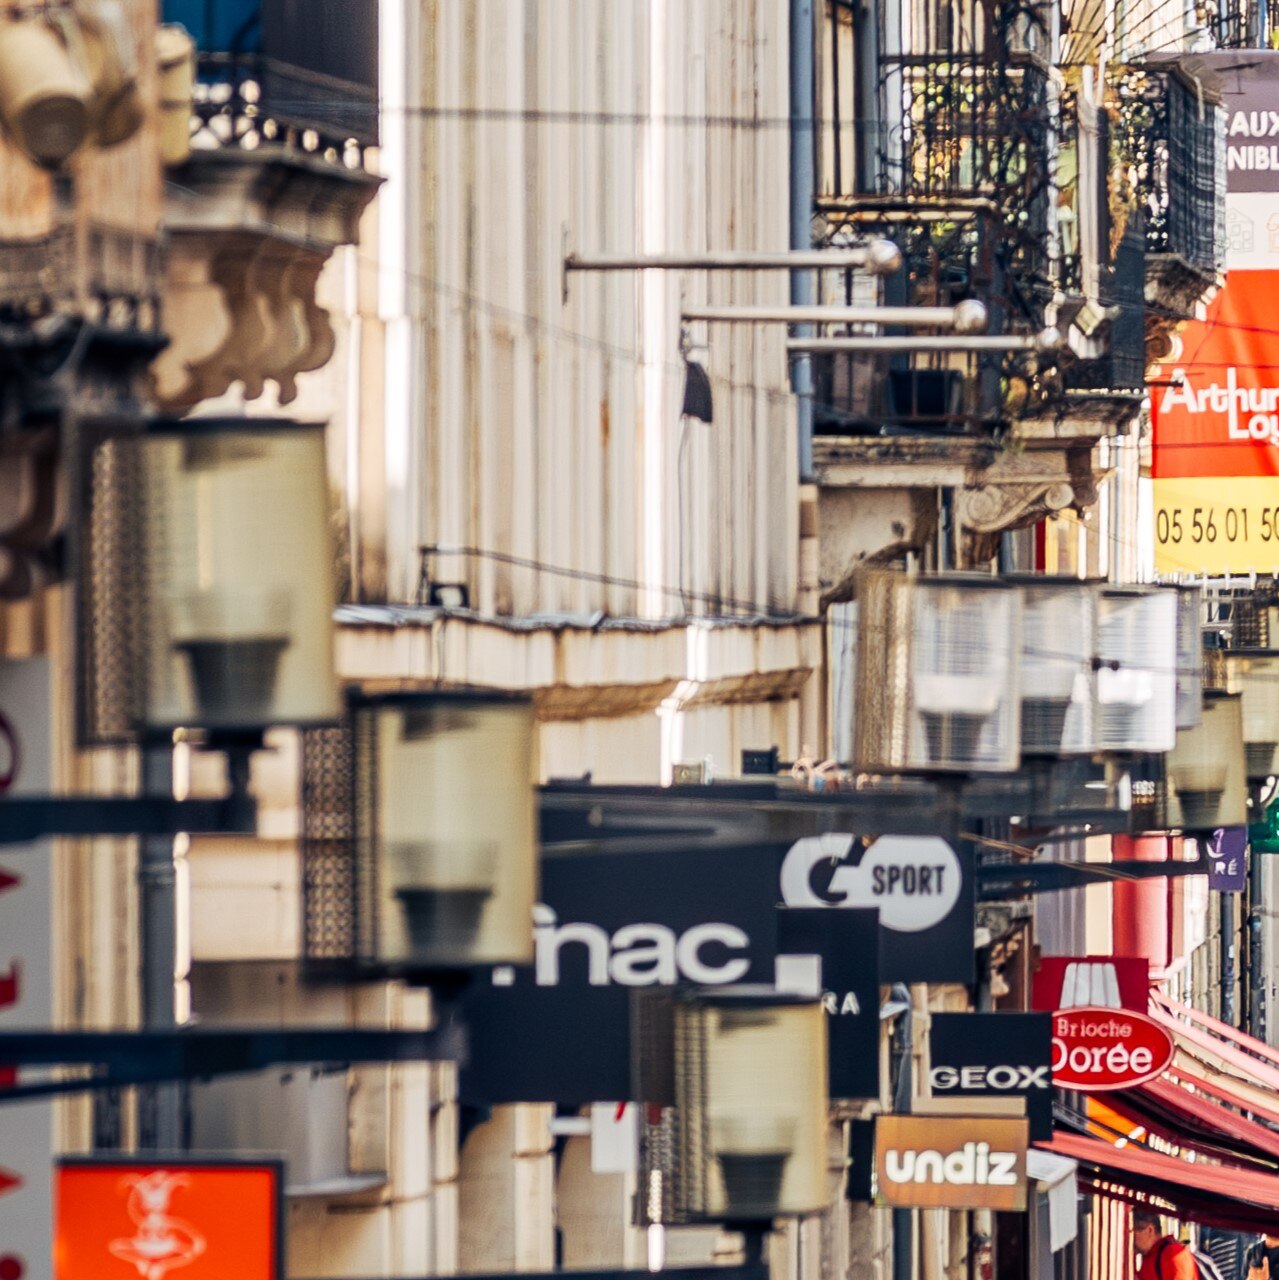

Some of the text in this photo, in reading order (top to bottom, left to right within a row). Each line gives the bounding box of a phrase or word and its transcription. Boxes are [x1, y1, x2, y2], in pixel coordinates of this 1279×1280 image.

[1156, 508, 1183, 545] 05
[1191, 507, 1218, 543] 56
[1225, 507, 1249, 543] 01
[872, 865, 946, 896] SPORT
[1057, 1019, 1133, 1038] Brioche
[929, 1065, 1049, 1090] GEOX
[884, 1141, 1018, 1186] undiz
